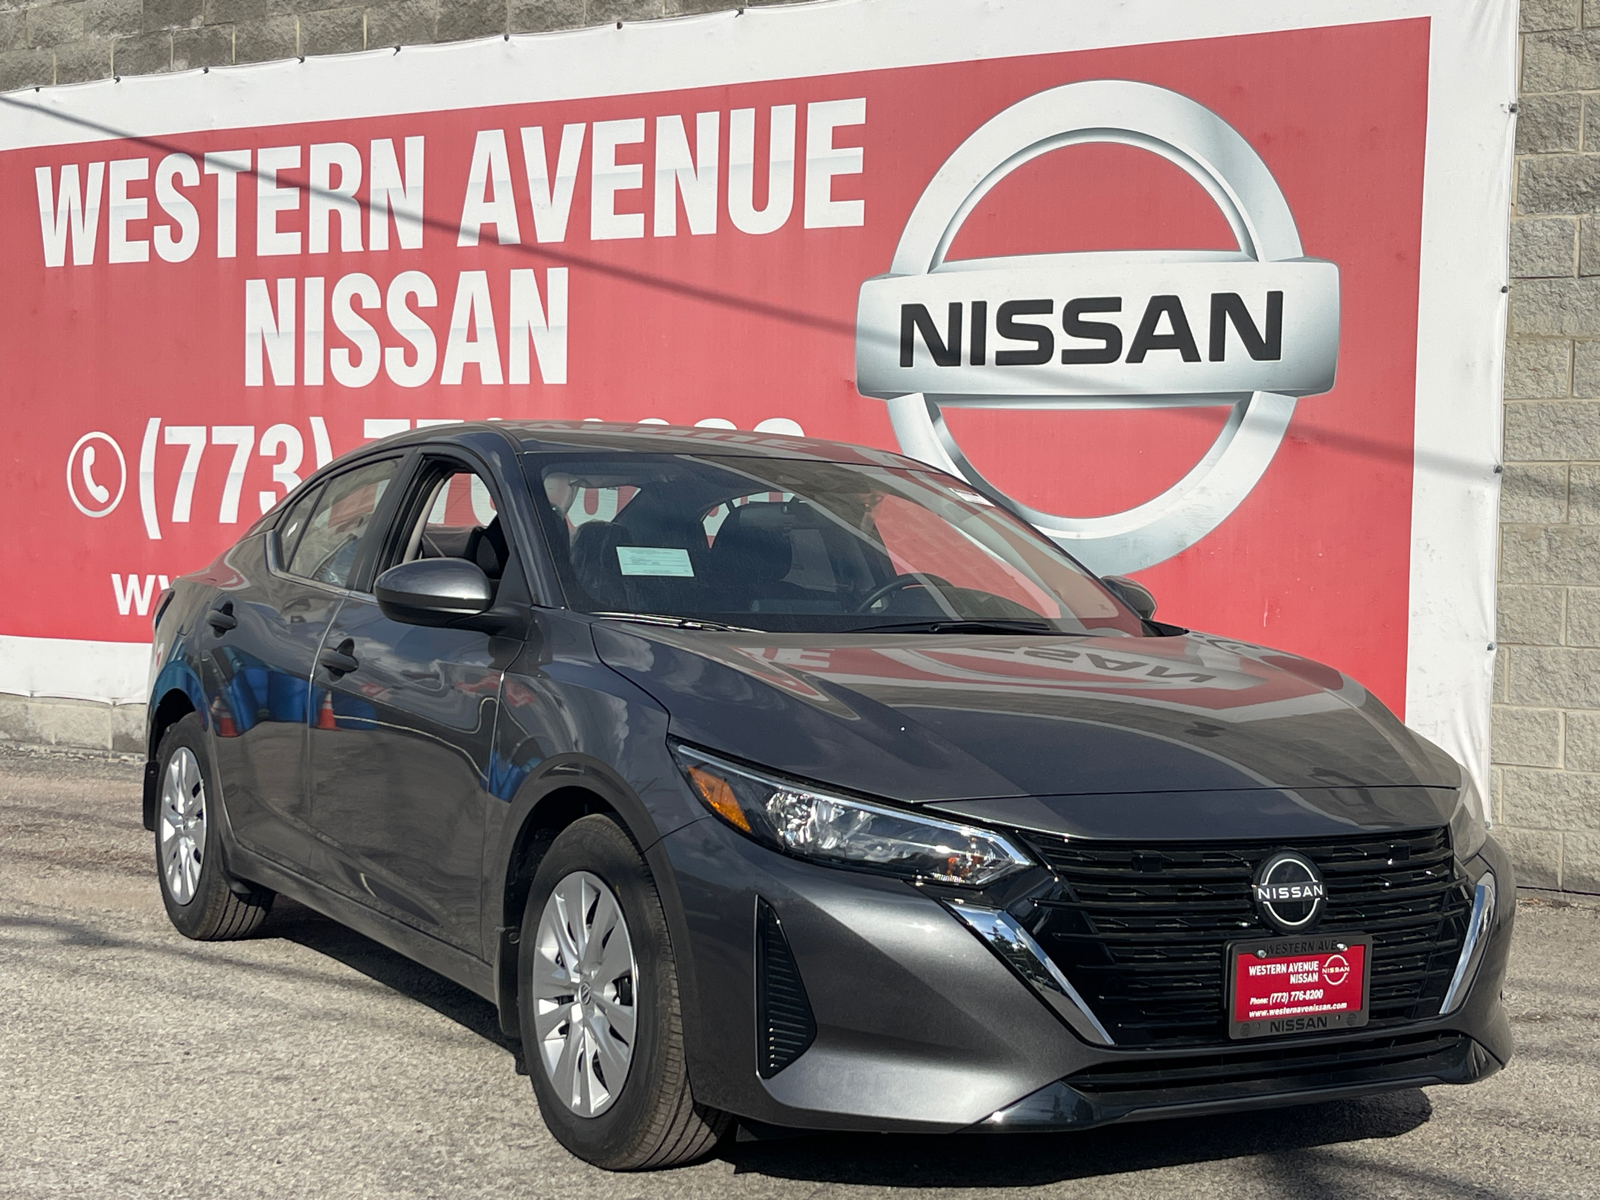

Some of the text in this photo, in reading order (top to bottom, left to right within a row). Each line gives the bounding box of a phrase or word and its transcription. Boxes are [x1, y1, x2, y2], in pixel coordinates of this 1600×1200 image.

[35, 97, 867, 267] WESTERN AVENUE
[244, 267, 569, 389] NISSAN
[899, 290, 1284, 368] NISSAN
[1257, 884, 1323, 900] NISSAN
[1266, 941, 1314, 955] WESTERN
[1249, 961, 1319, 976] WESTERN AVENUE
[1322, 966, 1350, 974] NISSAN
[1290, 973, 1319, 984] NISSAN
[1250, 989, 1324, 1005] Phone: (773) 776-8200
[1249, 1002, 1348, 1018] www.westernavenissan.com
[1270, 1016, 1328, 1033] NISSAN
